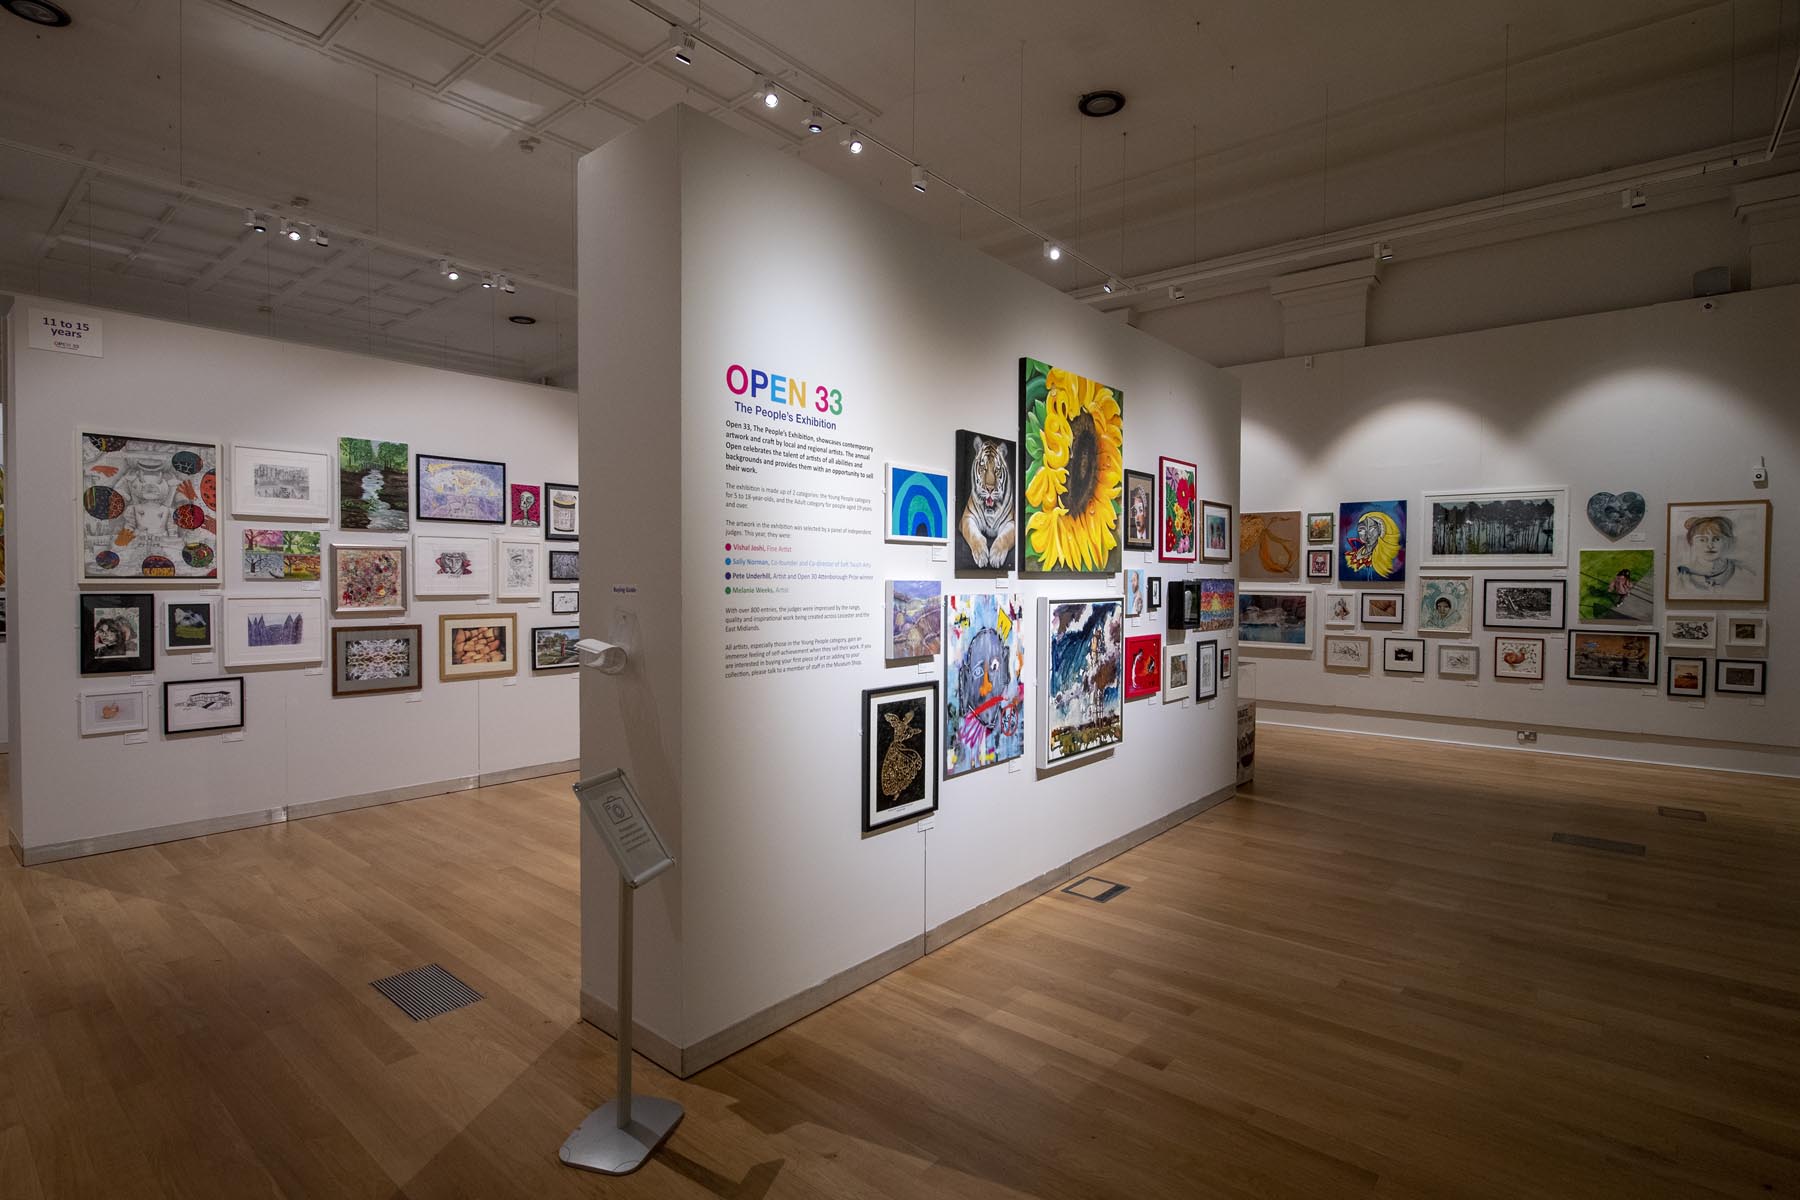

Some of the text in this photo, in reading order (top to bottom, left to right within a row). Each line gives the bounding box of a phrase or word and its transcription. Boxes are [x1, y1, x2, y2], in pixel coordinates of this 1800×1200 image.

[43, 317, 89, 331] 11 to 15
[51, 328, 82, 338] years
[726, 364, 842, 415] OPEN 33
[735, 401, 836, 430] The People's Exhibition
[726, 420, 742, 428] Open
[743, 423, 752, 431] 33,
[765, 427, 787, 436] People's
[789, 431, 815, 442] Exhibition,
[816, 436, 841, 446] showcases
[842, 442, 873, 452] contemporary
[726, 442, 742, 450] Open
[743, 445, 771, 454] celebrates
[726, 452, 762, 464] backgrounds
[775, 461, 797, 469] provides
[832, 469, 859, 478] opportunity
